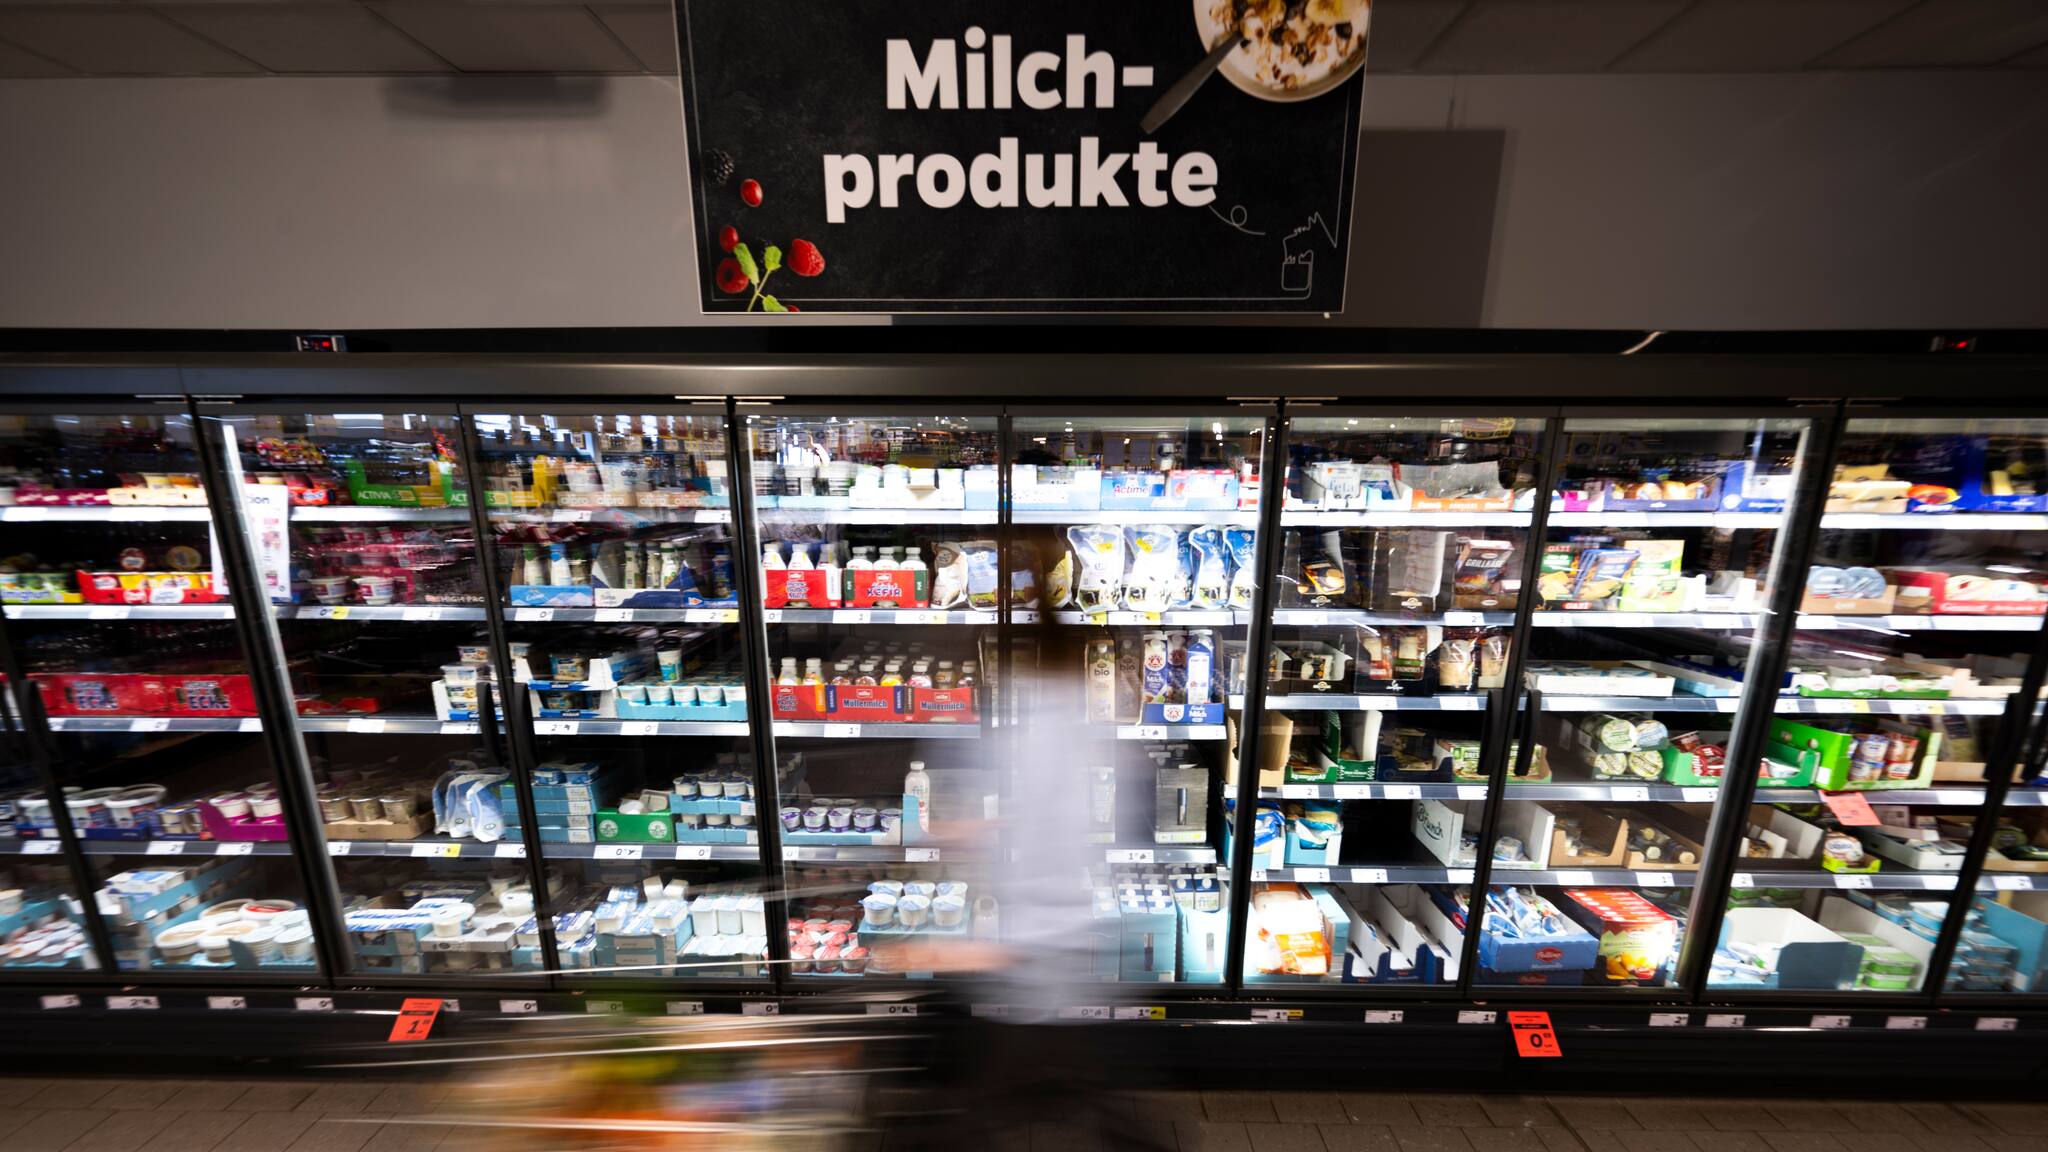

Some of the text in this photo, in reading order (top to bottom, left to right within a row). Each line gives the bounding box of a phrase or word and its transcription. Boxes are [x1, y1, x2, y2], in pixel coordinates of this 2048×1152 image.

[886, 25, 1154, 110] Milch-
[823, 137, 1218, 224] produkte
[867, 588, 902, 597] KEFIR
[843, 698, 888, 708] Müllermilch
[1416, 803, 1444, 838] Brunch
[407, 1020, 419, 1034] 1
[1530, 1034, 1543, 1048] 0
